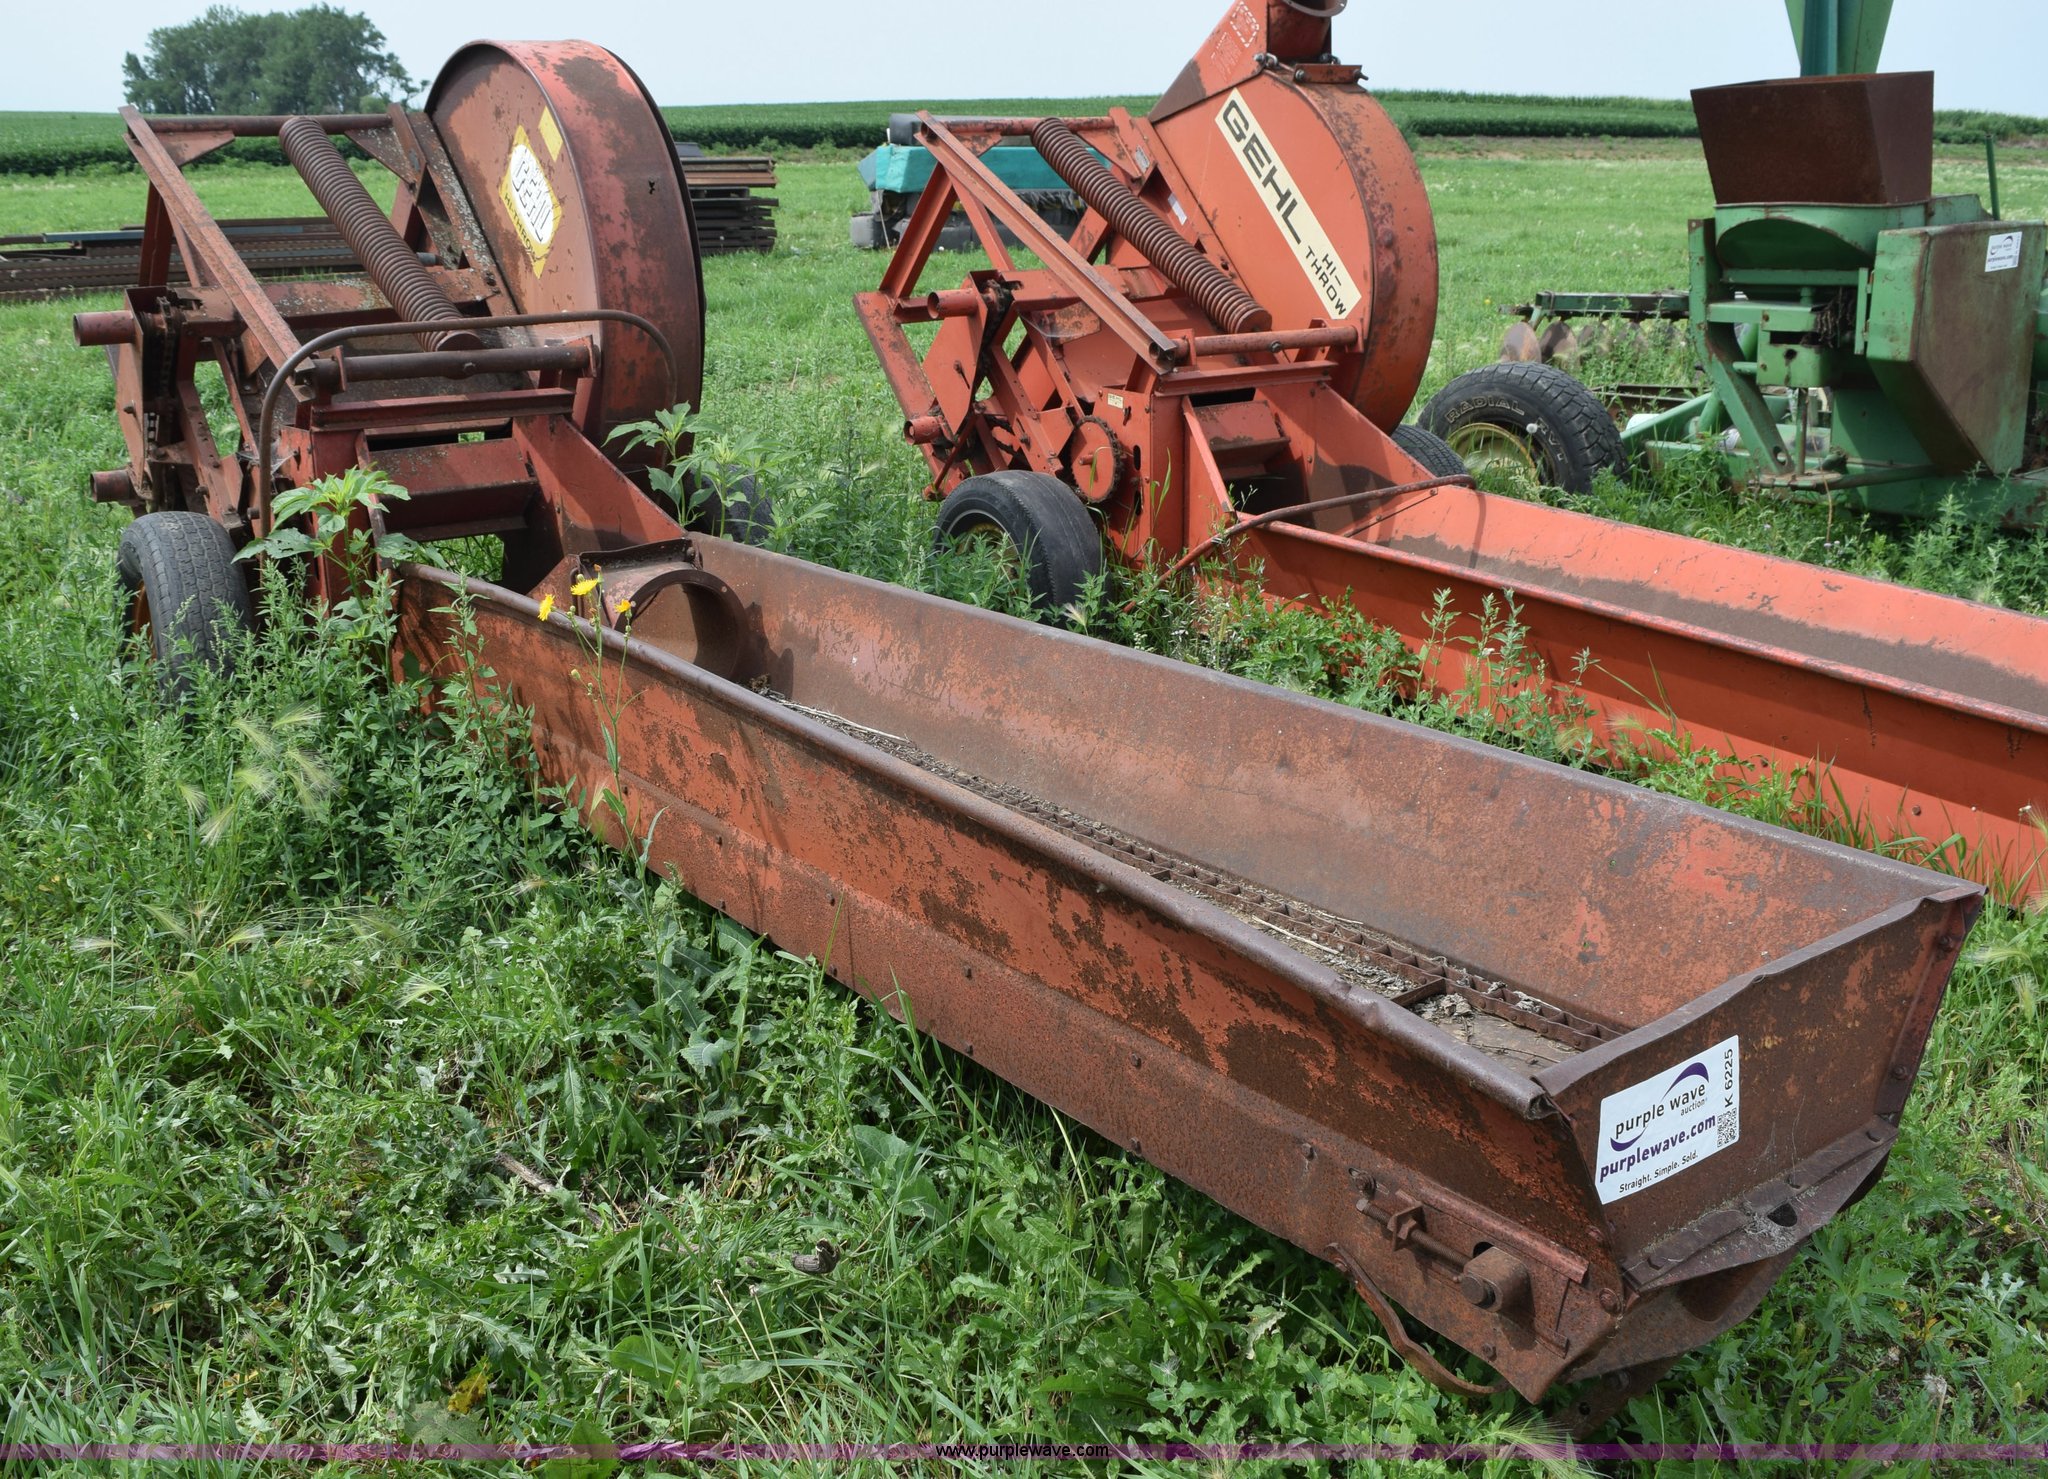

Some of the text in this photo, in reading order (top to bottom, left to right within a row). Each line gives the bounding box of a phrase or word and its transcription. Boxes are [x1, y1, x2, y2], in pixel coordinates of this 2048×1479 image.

[512, 160, 552, 242] GEHL
[1222, 99, 1302, 245] GEHL
[1305, 246, 1347, 316] THROW
[1445, 395, 1525, 424] RADIAL
[1724, 1048, 1734, 1108] K 6225
[1615, 1083, 1706, 1139] purple wave
[1600, 1115, 1716, 1183] purplewave.com
[1619, 1150, 1699, 1193] Straight. Simple. Sold.
